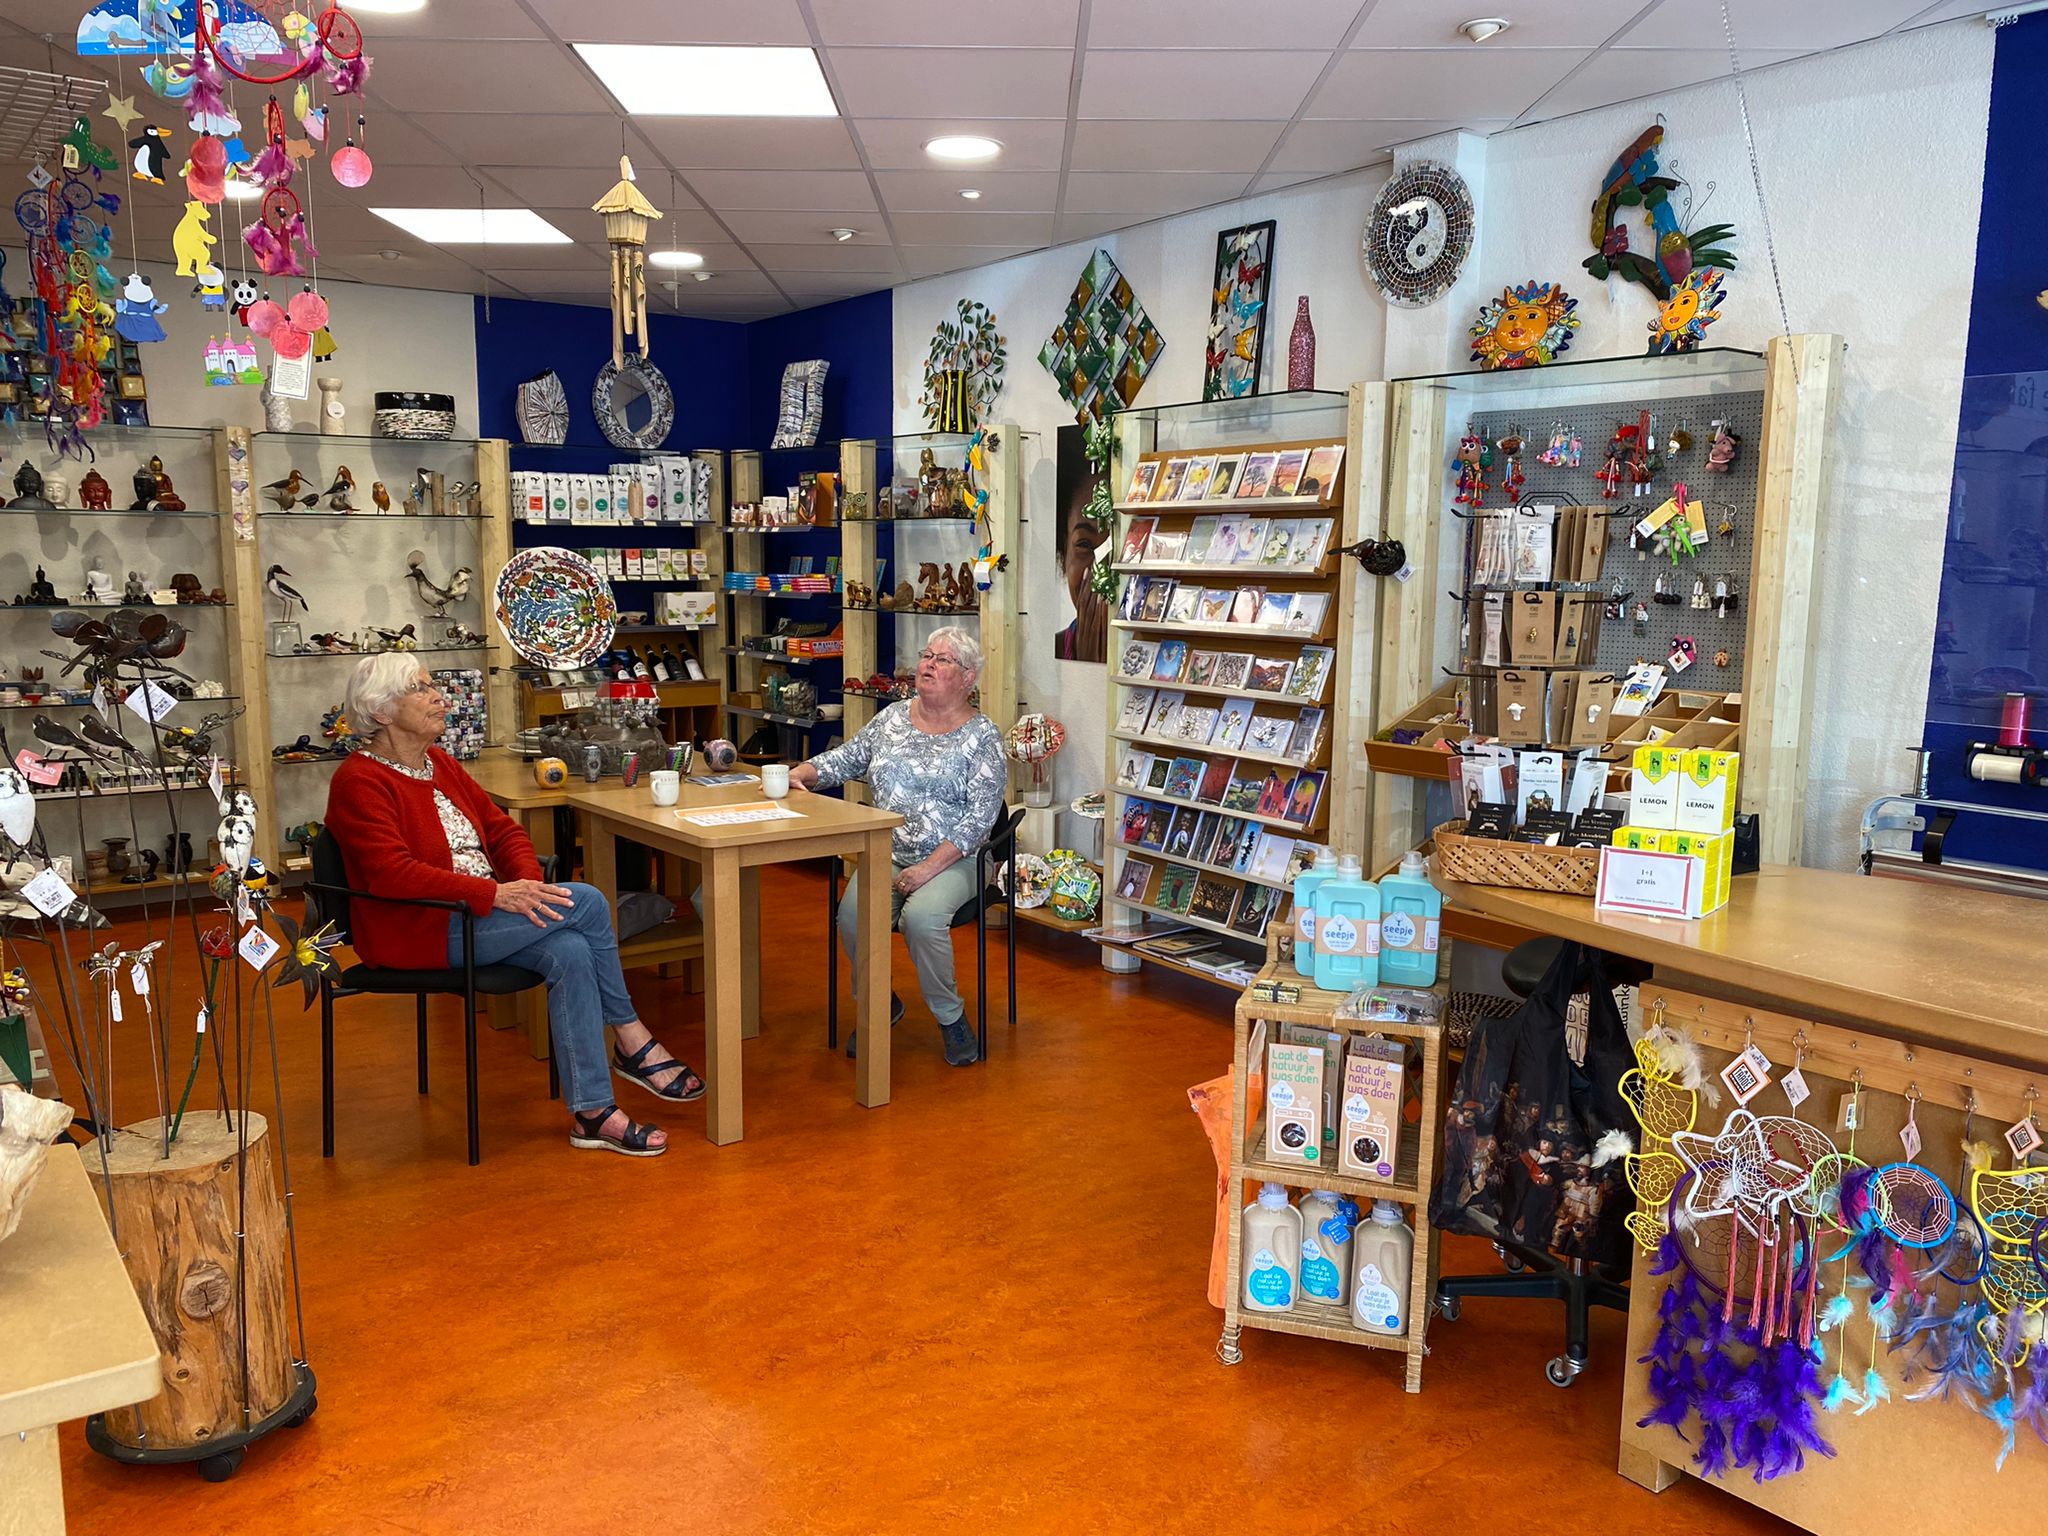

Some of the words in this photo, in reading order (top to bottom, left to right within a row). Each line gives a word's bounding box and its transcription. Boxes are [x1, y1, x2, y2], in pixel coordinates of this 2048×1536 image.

[1639, 797, 1667, 805] LEMON
[1686, 801, 1714, 810] LEMON
[1325, 930, 1355, 940] seepje
[1384, 926, 1413, 936] seepje
[1315, 1035, 1328, 1046] de
[1354, 1040, 1376, 1053] Laat
[1378, 1045, 1390, 1056] de
[1272, 1049, 1295, 1060] Laat
[1296, 1051, 1308, 1062] de
[1272, 1060, 1303, 1072] natuur
[1305, 1062, 1315, 1075] je
[1349, 1061, 1372, 1075] Laat
[1374, 1066, 1386, 1077] de
[1271, 1072, 1293, 1081] was
[1295, 1073, 1319, 1084] doen
[1348, 1074, 1381, 1087] natuur
[1382, 1077, 1392, 1090] je
[1734, 1069, 1752, 1089] TRADE
[1347, 1085, 1369, 1096] was
[1371, 1087, 1396, 1101] doen
[1346, 1105, 1368, 1115] seepje
